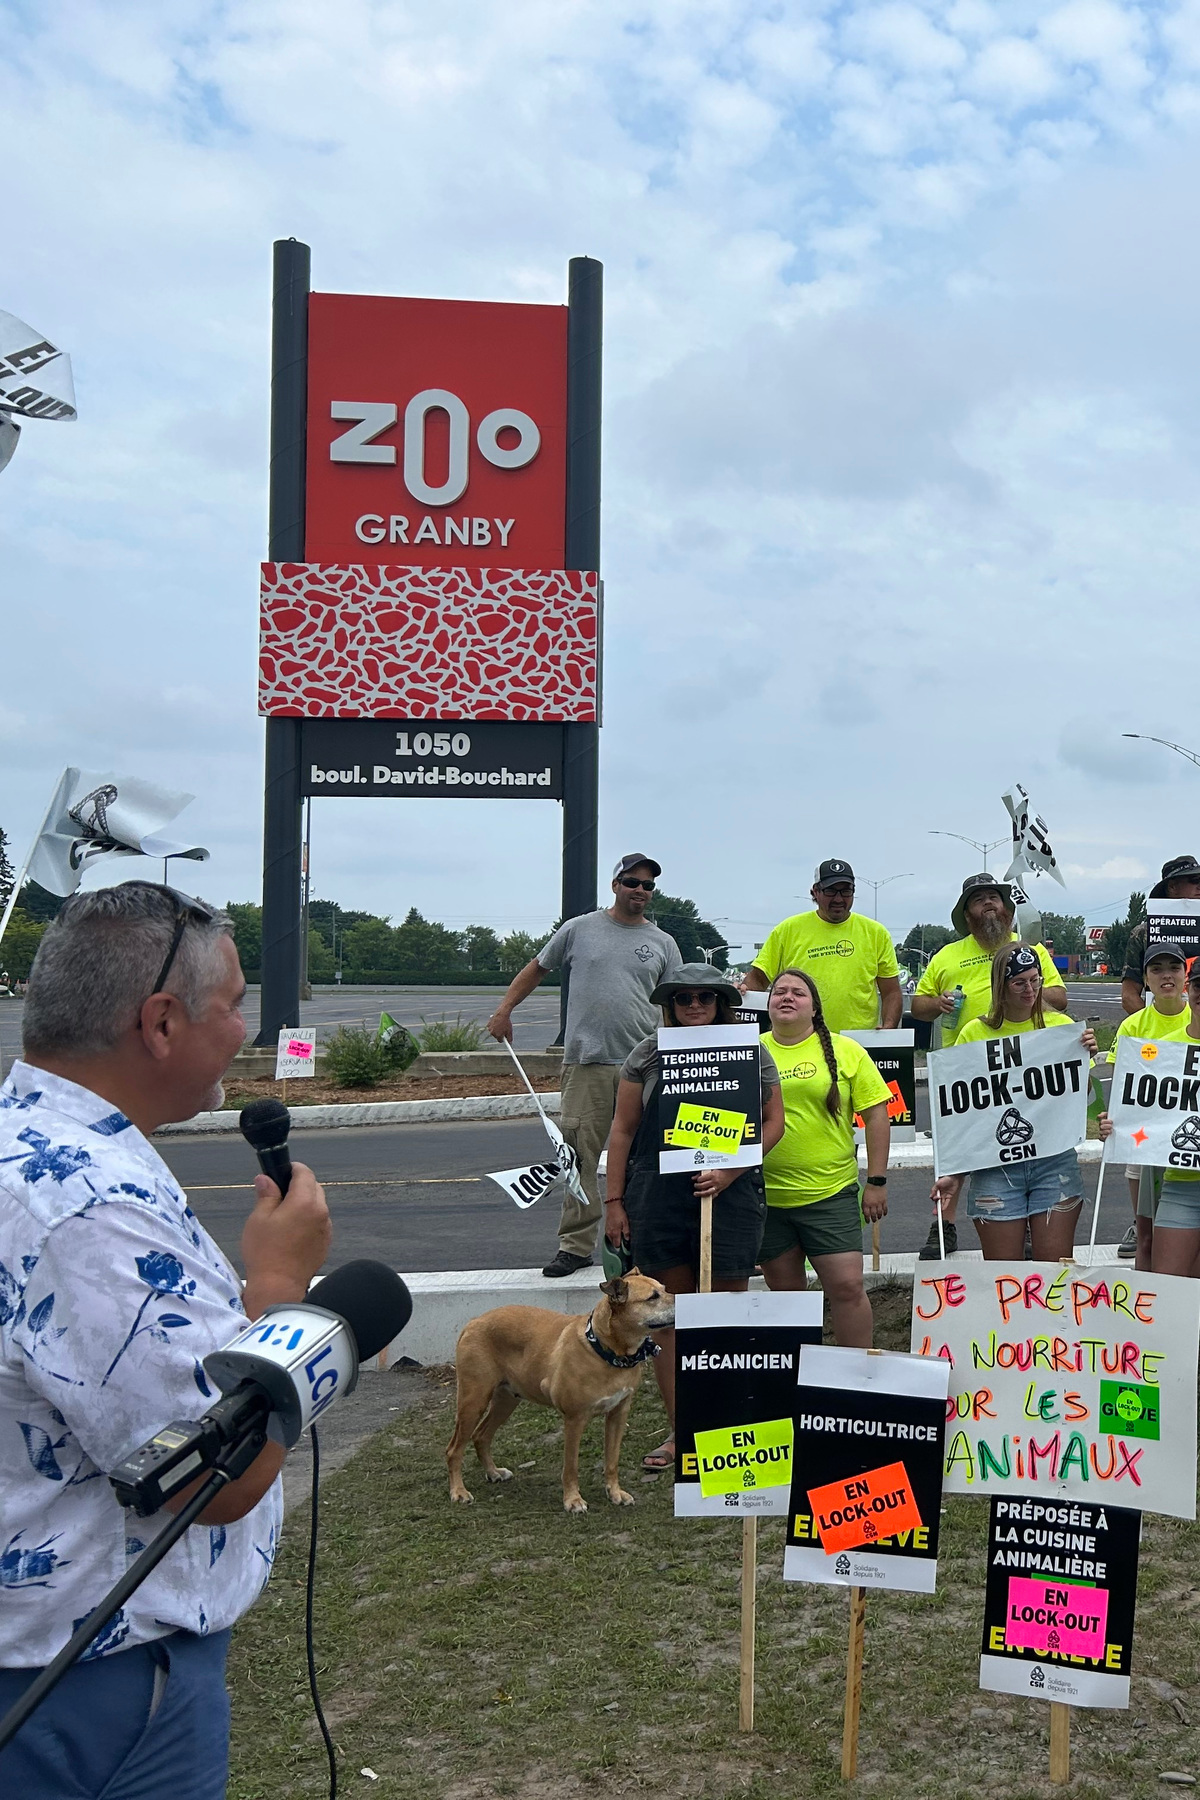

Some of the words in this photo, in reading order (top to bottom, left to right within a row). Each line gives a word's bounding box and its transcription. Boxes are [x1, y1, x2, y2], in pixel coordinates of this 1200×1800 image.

[355, 513, 516, 547] GRANBY
[395, 732, 471, 756] 1050
[310, 765, 367, 784] boul.
[373, 766, 551, 786] David-Bouchard
[1150, 917, 1197, 927] OPÉRATEUR
[1150, 926, 1160, 934] DE
[1150, 935, 1199, 944] MACHINERIE
[662, 1050, 754, 1065] TECHNICIENNE
[986, 1035, 1022, 1071] EN
[662, 1069, 680, 1080] EN
[682, 1066, 720, 1079] SOINS
[662, 1080, 740, 1095] ANIMALIERS
[939, 1059, 1082, 1117] LOCK-OUT
[702, 1111, 720, 1123] EN
[677, 1120, 739, 1139] LOCK-OUT
[999, 1144, 1037, 1162] CSN
[916, 1273, 967, 1321] JE
[994, 1269, 1157, 1326] PRÉPARE
[681, 1350, 793, 1370] MÉCANICIEN
[945, 1387, 998, 1423] OUR
[1024, 1381, 1091, 1424] LES
[800, 1414, 937, 1441] HORTICULTRICE
[732, 1430, 755, 1447] EN
[702, 1445, 790, 1472] LOCK-OUT
[844, 1479, 870, 1501] EN
[818, 1489, 906, 1530] LOCK-OUT
[996, 1500, 1091, 1528] PRÉPOSÉE
[1095, 1508, 1109, 1531] À
[995, 1525, 1019, 1543] LA
[1023, 1528, 1097, 1553] CUISINE
[993, 1550, 1107, 1579] ANIMALIÈRE
[1044, 1588, 1069, 1607] EN
[1011, 1605, 1100, 1633] LOCK-OUT
[1029, 1680, 1045, 1689] CSN
